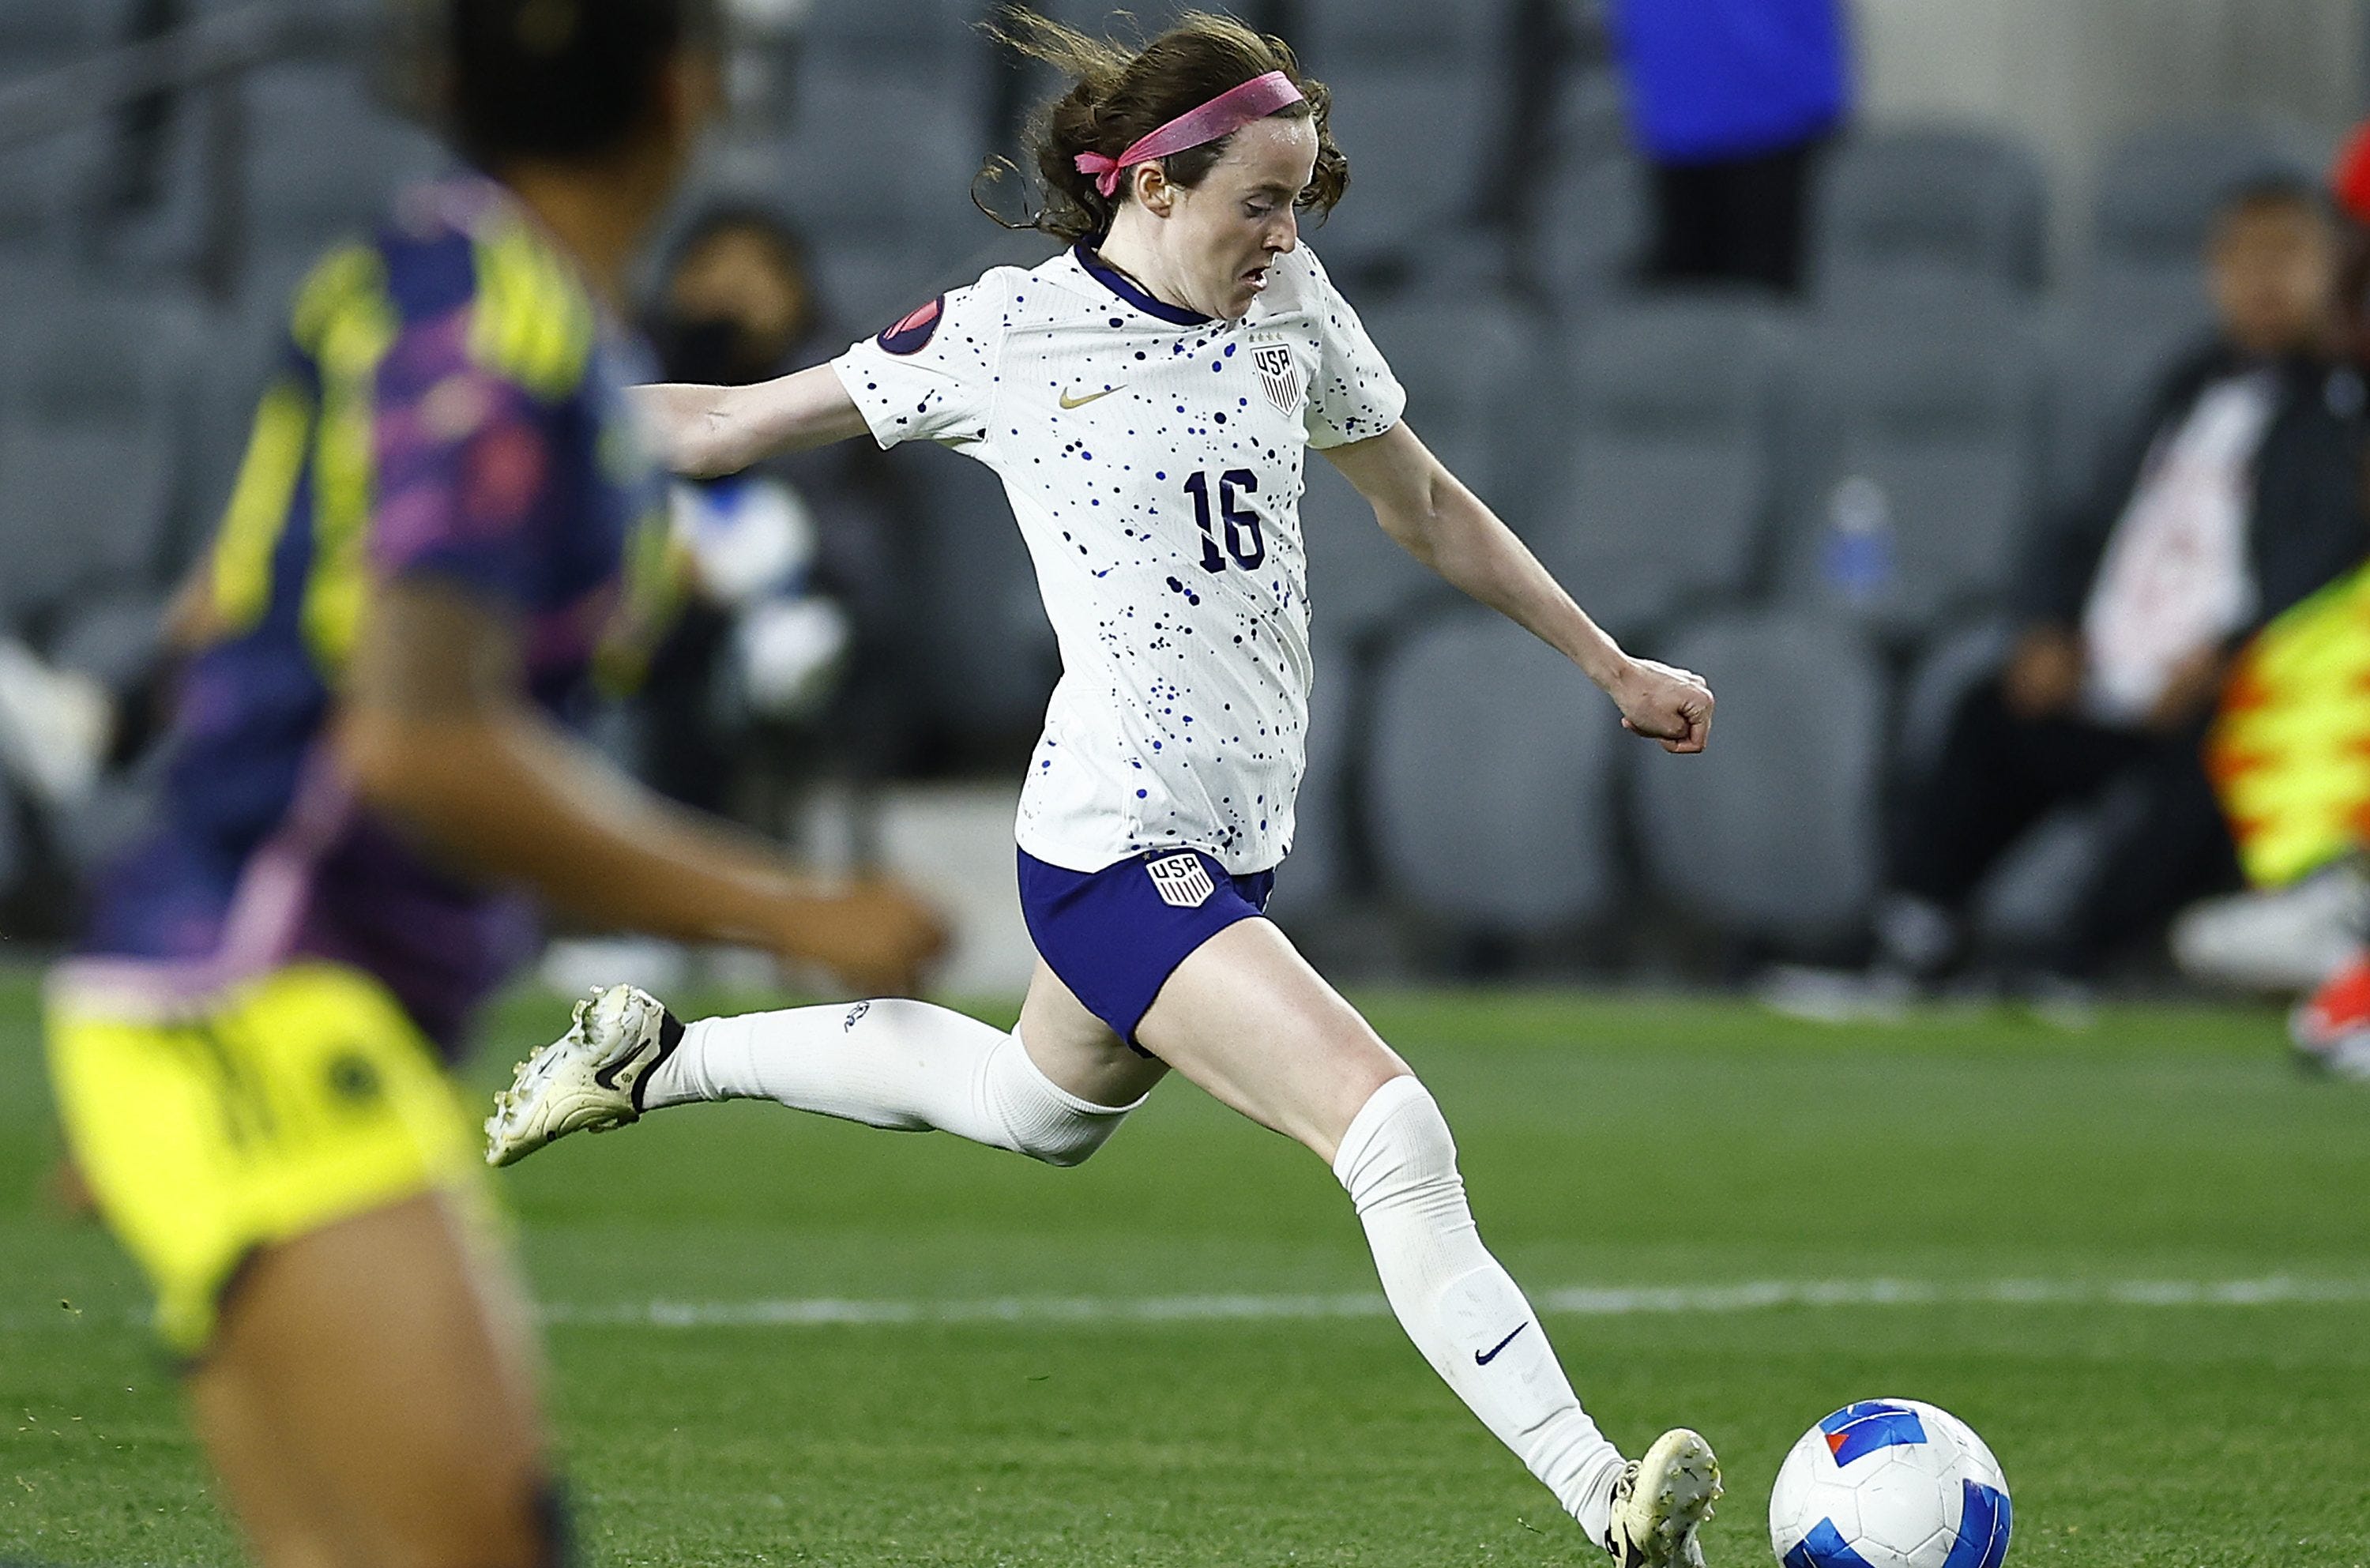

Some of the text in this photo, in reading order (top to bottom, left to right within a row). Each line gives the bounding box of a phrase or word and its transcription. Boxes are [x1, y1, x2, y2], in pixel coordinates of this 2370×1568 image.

[1255, 349, 1290, 376] USA
[1184, 468, 1264, 573] 16
[1152, 857, 1198, 878] USA
